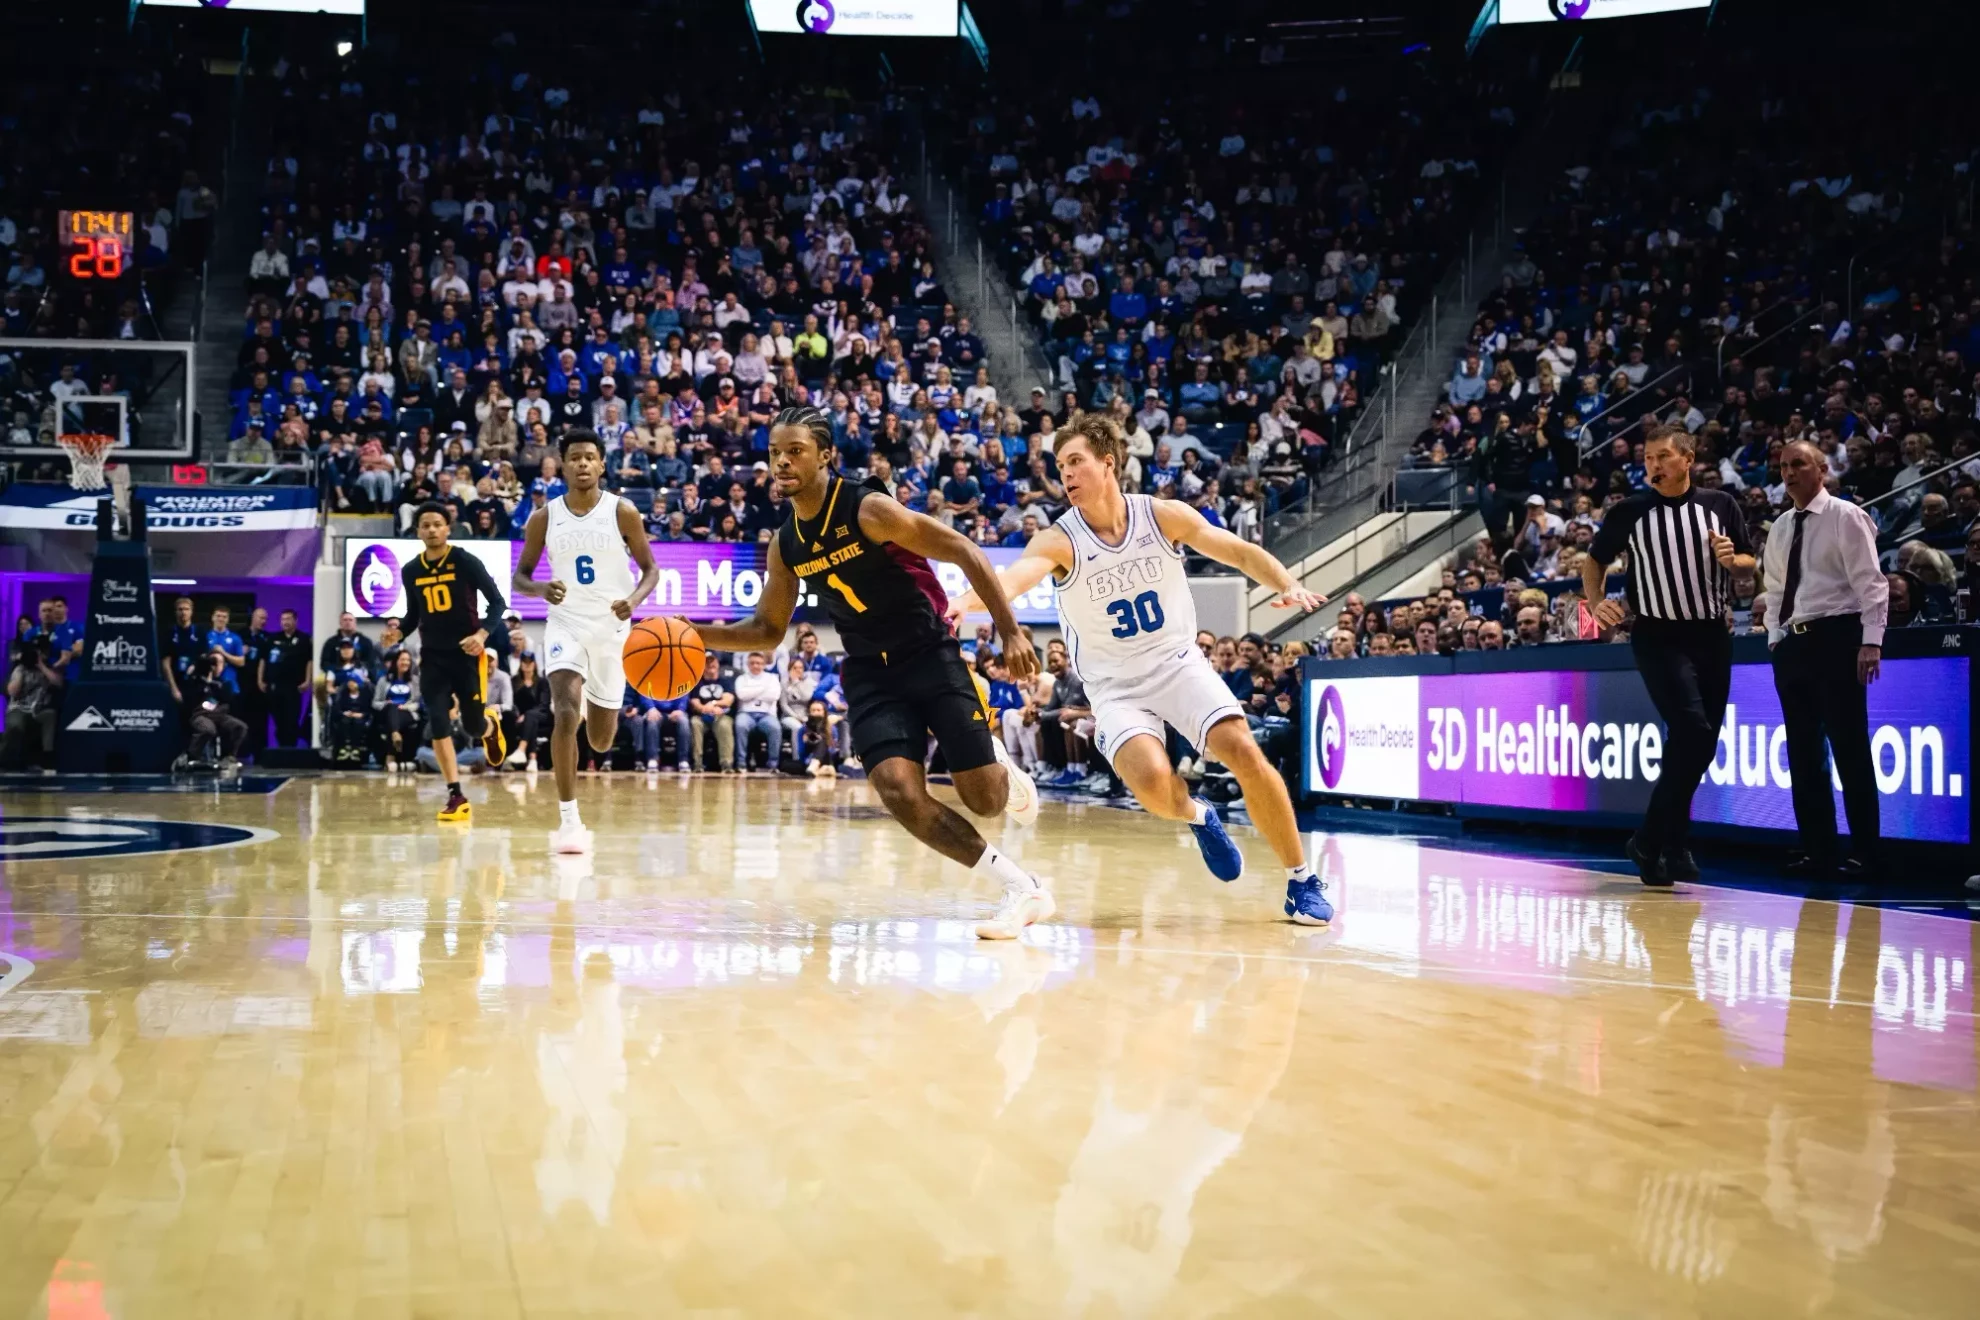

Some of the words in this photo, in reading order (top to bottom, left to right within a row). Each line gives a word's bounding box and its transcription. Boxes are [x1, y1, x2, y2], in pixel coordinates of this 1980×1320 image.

[72, 211, 129, 234] 17:41
[70, 237, 122, 278] 28
[155, 495, 275, 504] MOUNTAIN
[146, 516, 245, 527] OUGS
[555, 530, 611, 554] BYU
[829, 541, 864, 566] STATE
[575, 555, 595, 585] 6
[1087, 556, 1164, 601] BYU
[423, 584, 452, 613] 10
[827, 573, 868, 613] 1
[1106, 590, 1165, 639] 30
[1348, 726, 1378, 748] Health
[1380, 725, 1414, 748] Decide
[1426, 707, 1467, 771] 3D
[1476, 704, 1663, 782] Healthcare
